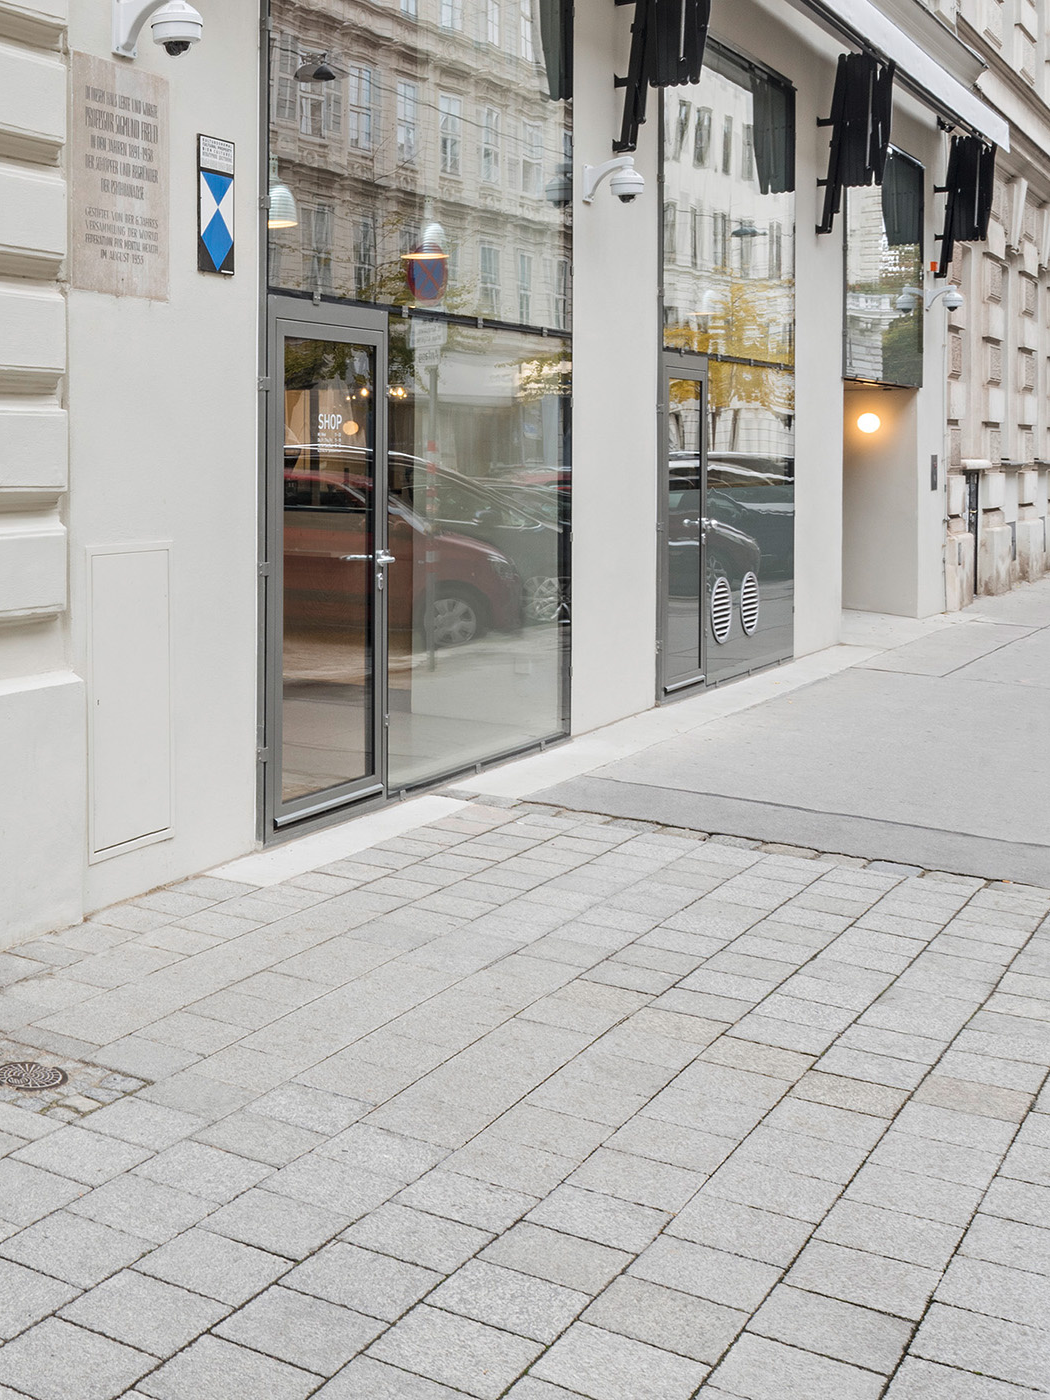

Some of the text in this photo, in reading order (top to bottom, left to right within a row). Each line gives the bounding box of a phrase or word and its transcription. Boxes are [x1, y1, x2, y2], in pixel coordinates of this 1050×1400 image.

[85, 106, 158, 144] PROFESSOR SIGMUND FREUD
[107, 138, 127, 157] JAHREN
[139, 229, 158, 242] WORLD
[109, 250, 129, 263] AUGUST
[318, 413, 343, 430] SHOP
